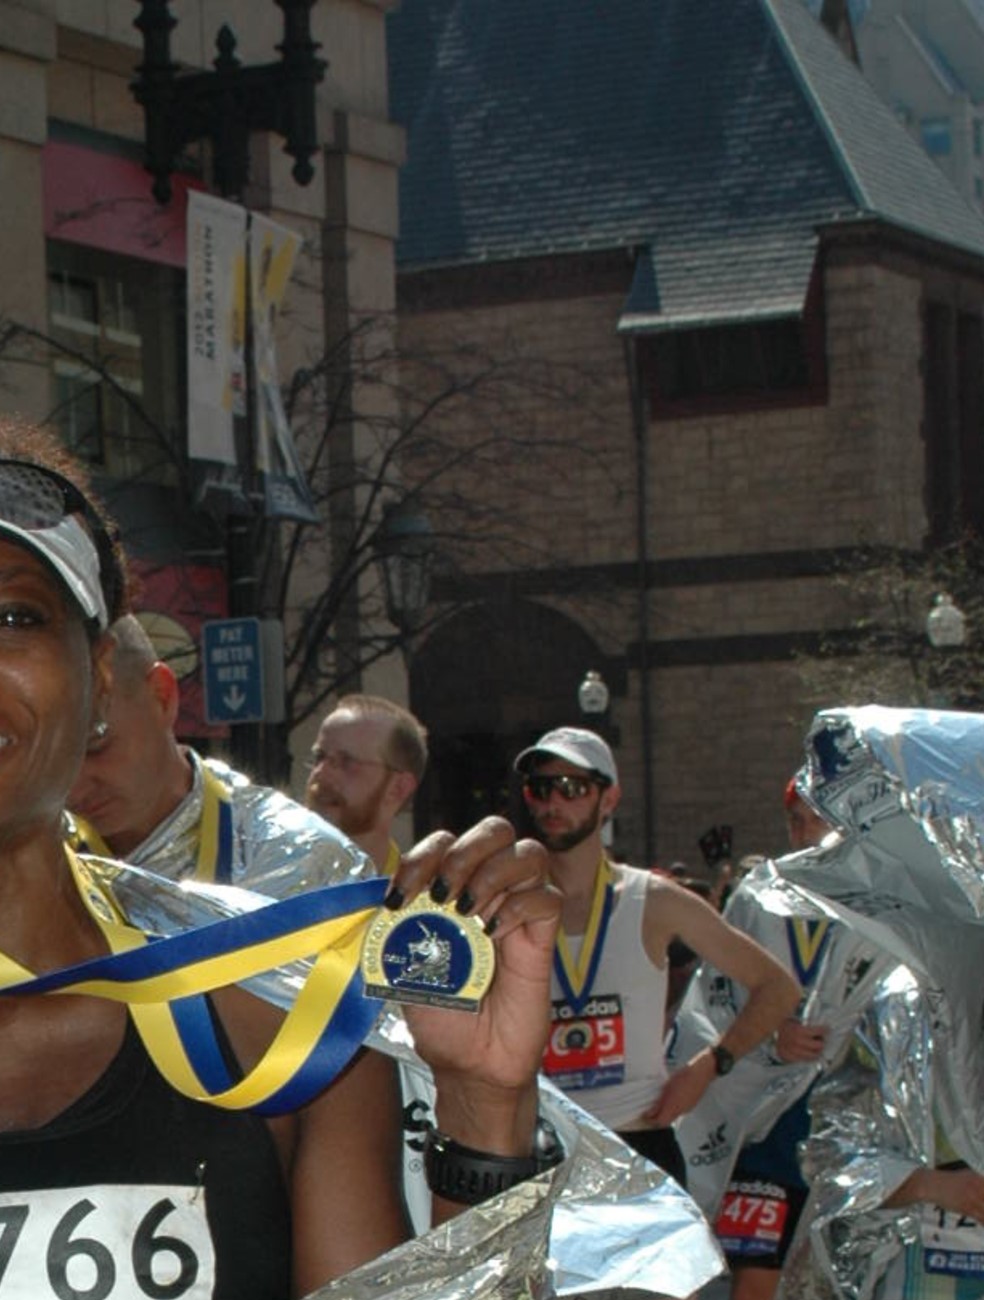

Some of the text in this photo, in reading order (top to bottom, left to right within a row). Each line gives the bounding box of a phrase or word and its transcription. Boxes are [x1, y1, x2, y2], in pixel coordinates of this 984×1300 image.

[204, 224, 216, 362] MARATHON
[219, 627, 243, 643] PAY
[211, 645, 254, 663] METER
[217, 665, 249, 682] HERE
[559, 1000, 619, 1019] adas
